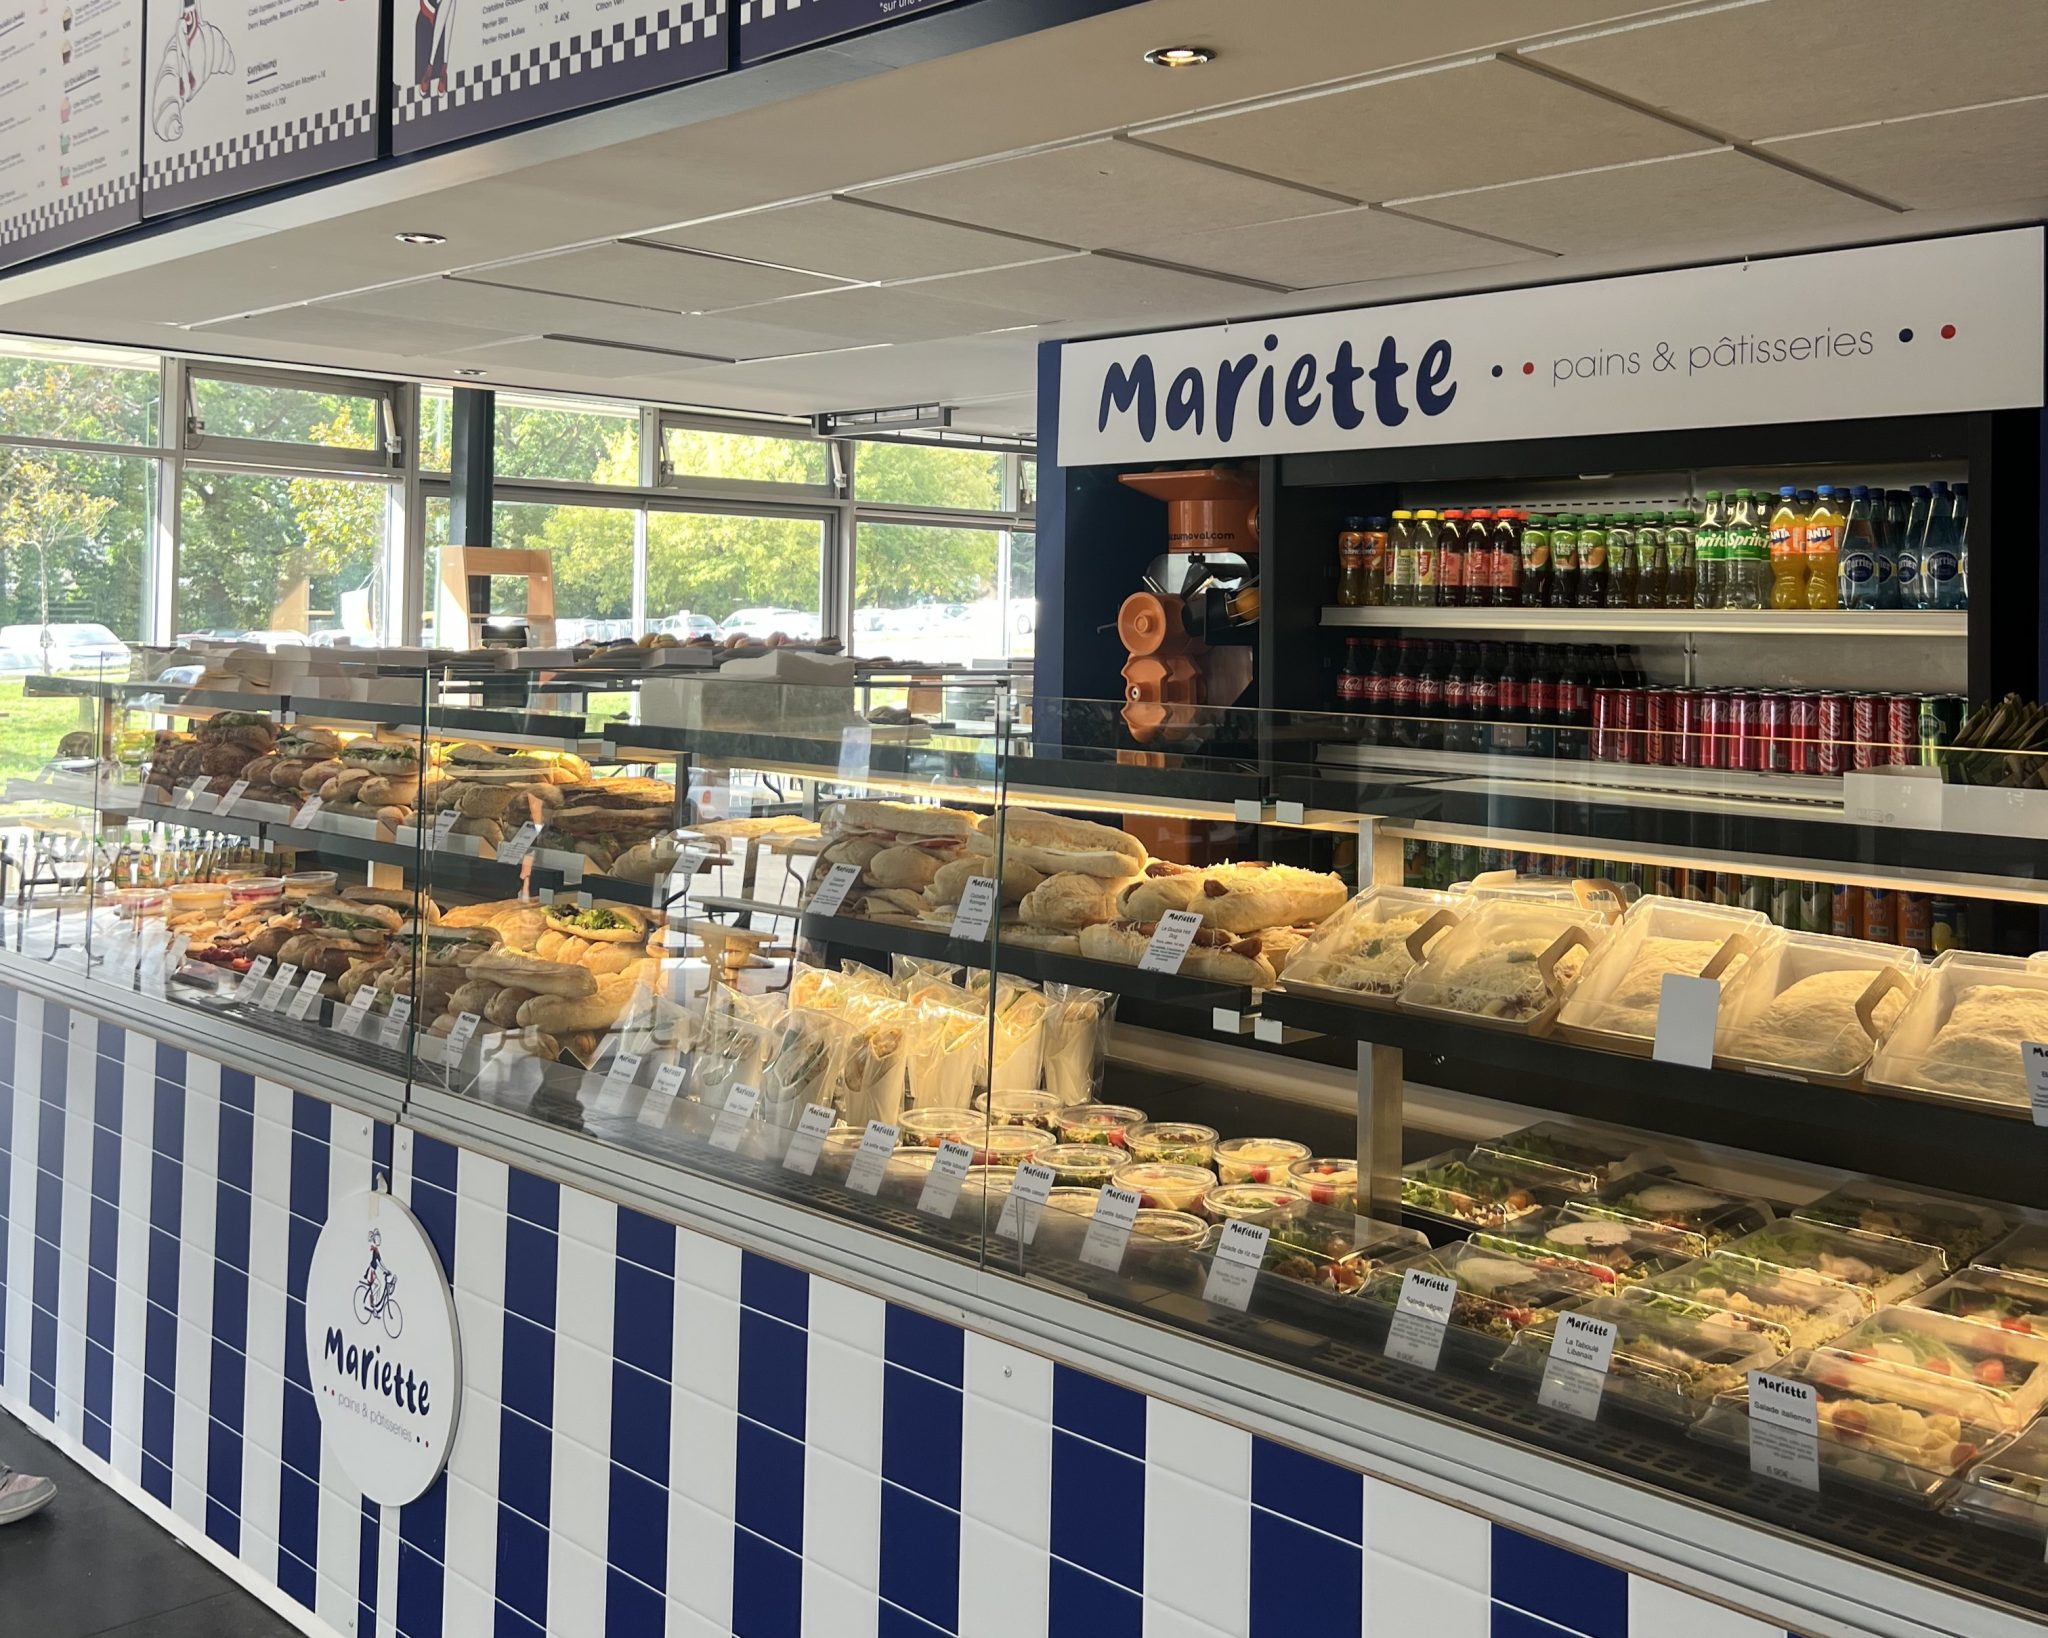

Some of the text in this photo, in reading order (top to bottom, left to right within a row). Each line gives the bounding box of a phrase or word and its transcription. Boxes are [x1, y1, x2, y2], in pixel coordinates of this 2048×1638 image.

[1099, 324, 1875, 443] Mariette pains & pâtisseries
[972, 878, 994, 889] Mariett
[1168, 913, 1197, 924] Mariette
[871, 1124, 895, 1137] Mariette
[943, 1143, 969, 1157] Mariette
[1022, 1165, 1050, 1180] Mariette
[1105, 1188, 1136, 1204] Mariette
[1231, 1223, 1263, 1240] Mariette
[1412, 1274, 1449, 1292] Mariette
[1566, 1316, 1608, 1336] Mariette
[1565, 1337, 1599, 1353] La Taboulé
[1567, 1347, 1593, 1361] Libanais
[324, 1326, 431, 1416] Mariette
[1758, 1376, 1807, 1400] Mariette
[338, 1393, 412, 1443] pains & pâtisseries
[1754, 1401, 1812, 1425] Salade italienne
